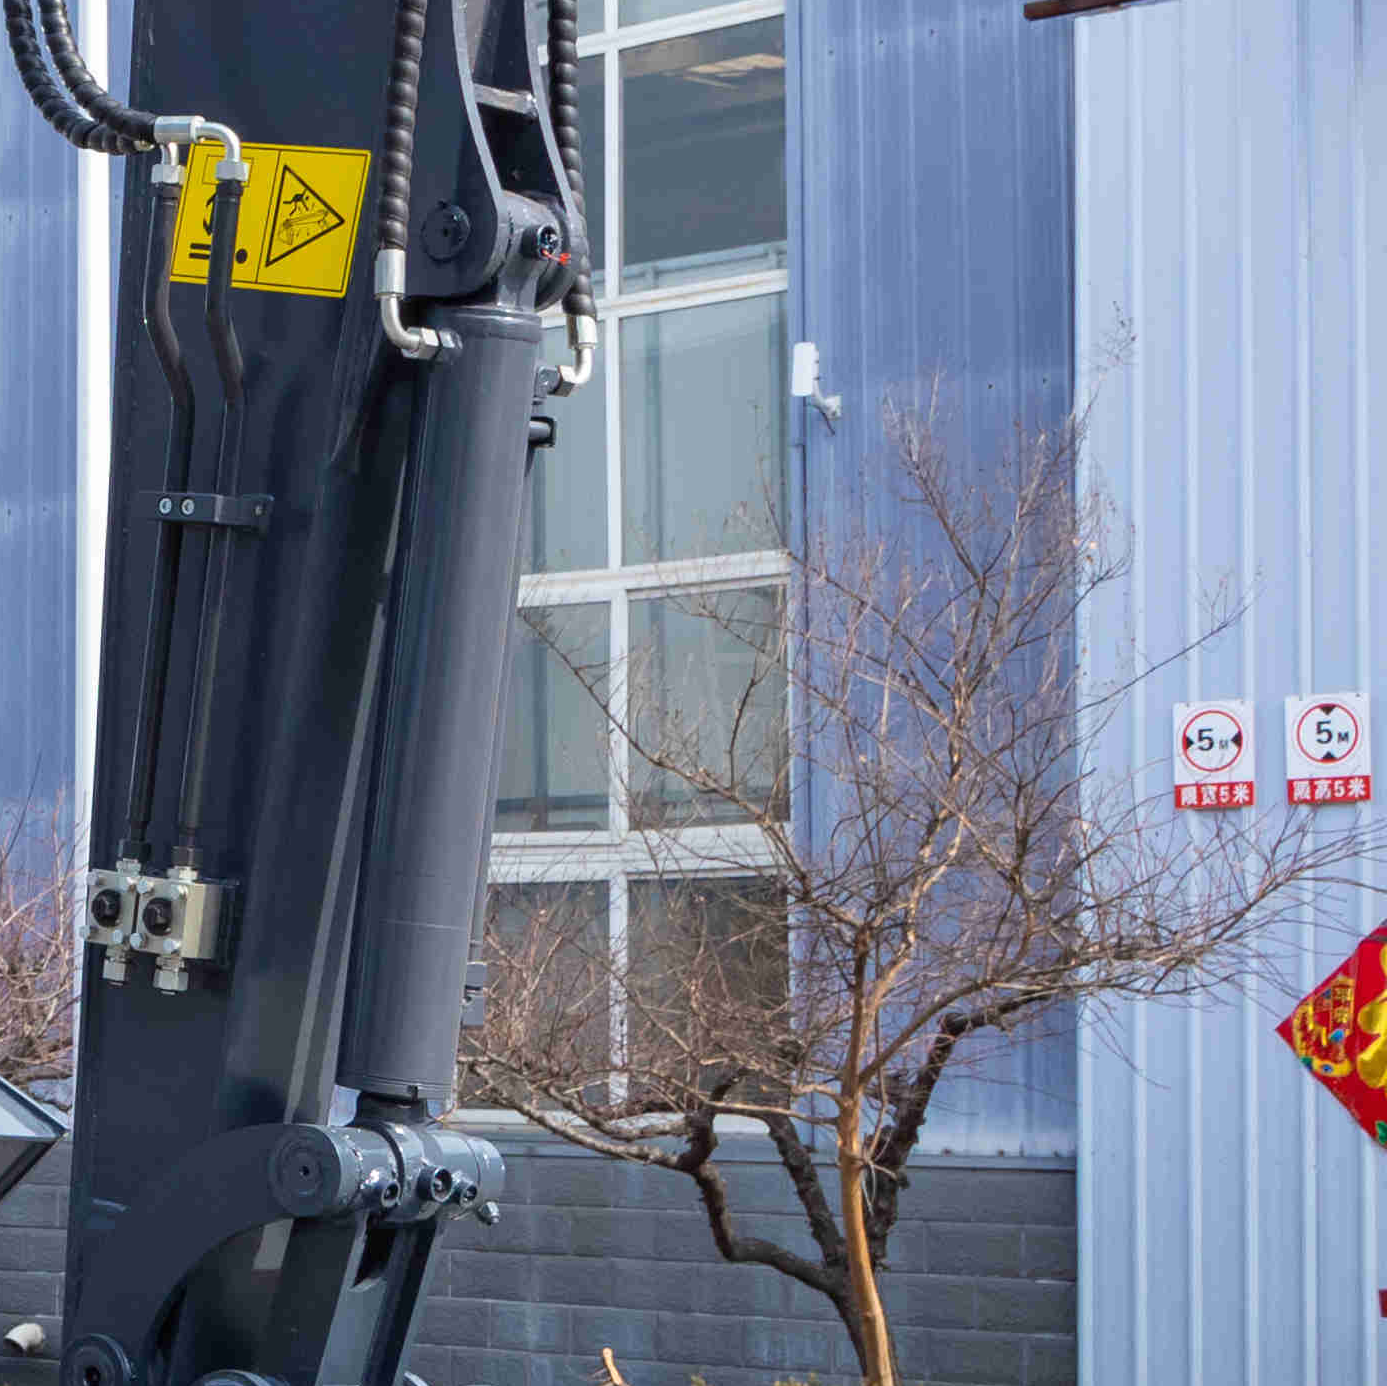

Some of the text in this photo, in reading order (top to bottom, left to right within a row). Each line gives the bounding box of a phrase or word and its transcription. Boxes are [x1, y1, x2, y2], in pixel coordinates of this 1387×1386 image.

[1180, 783, 1250, 805] 限宽5米
[1292, 778, 1366, 801] 限高5米
